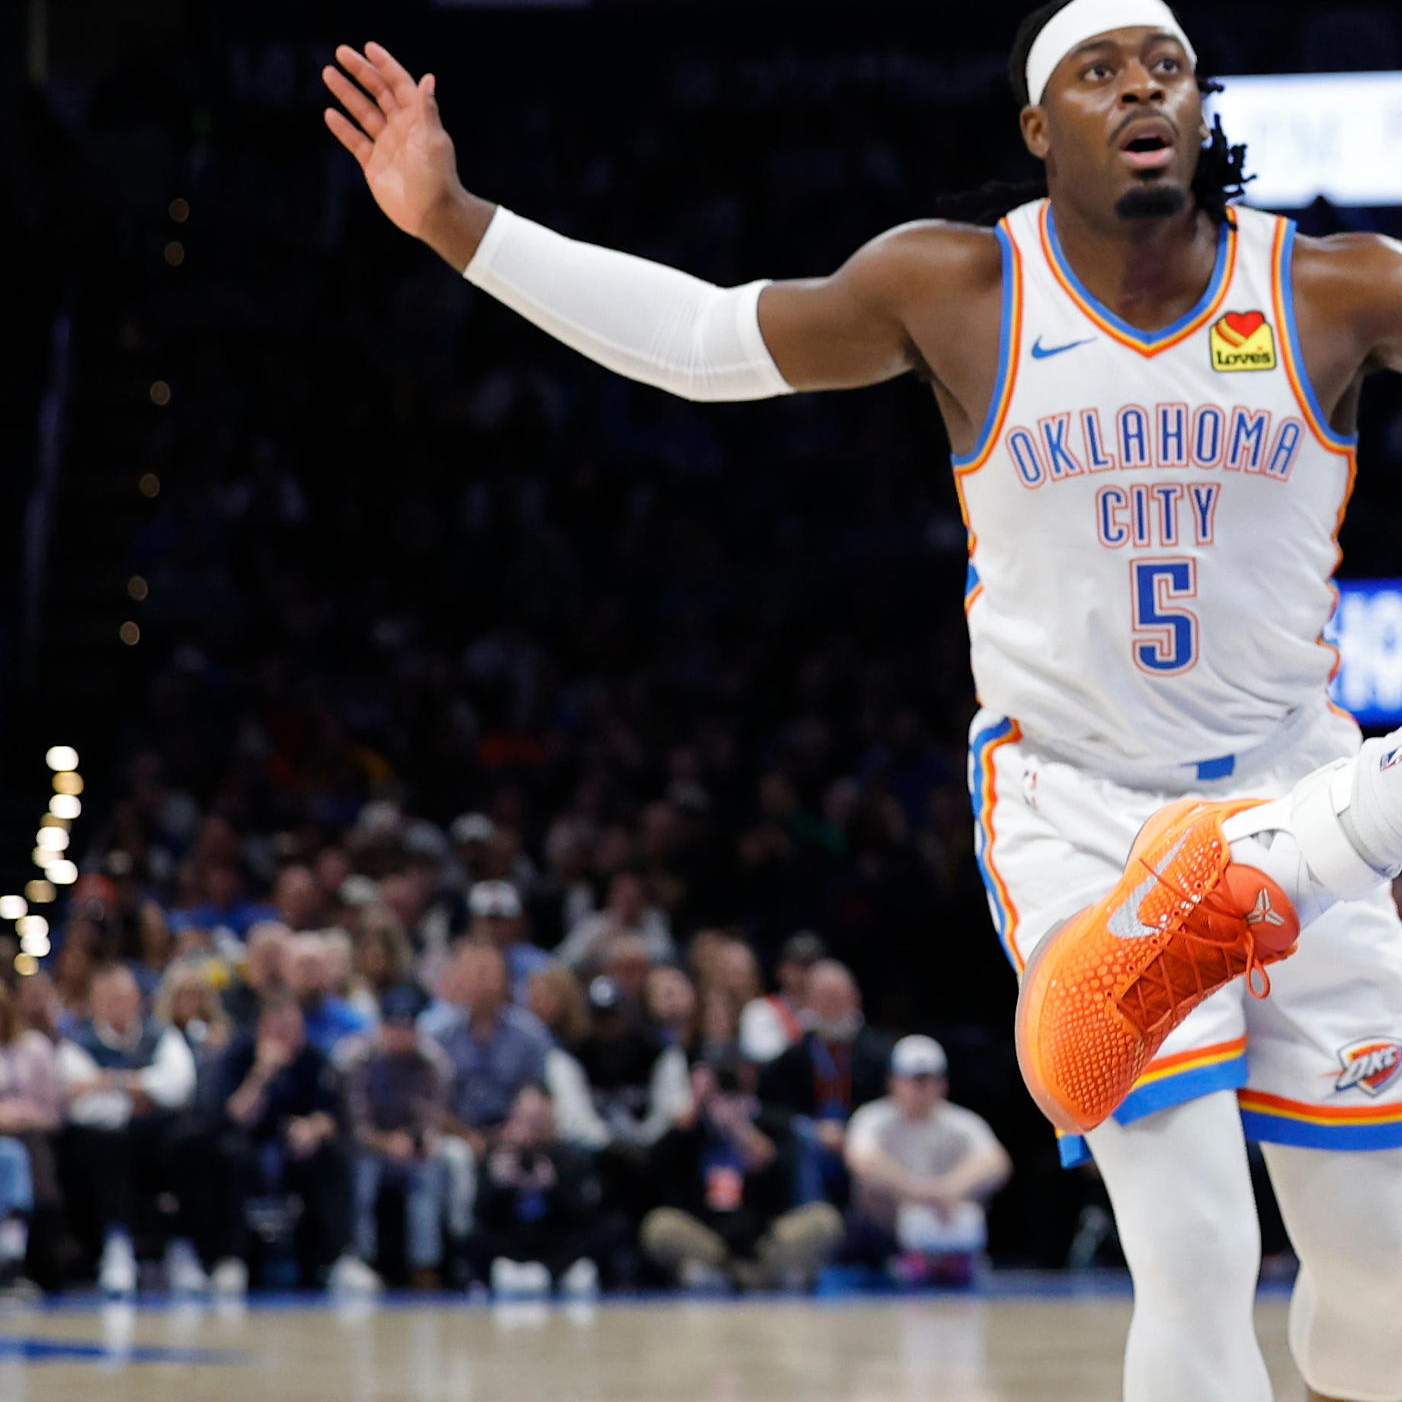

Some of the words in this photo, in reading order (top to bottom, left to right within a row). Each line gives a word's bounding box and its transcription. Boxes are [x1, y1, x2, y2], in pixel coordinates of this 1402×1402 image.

[1006, 402, 1306, 491] OKLAHOMA
[1095, 482, 1221, 549] CITY
[1129, 555, 1200, 678] 5
